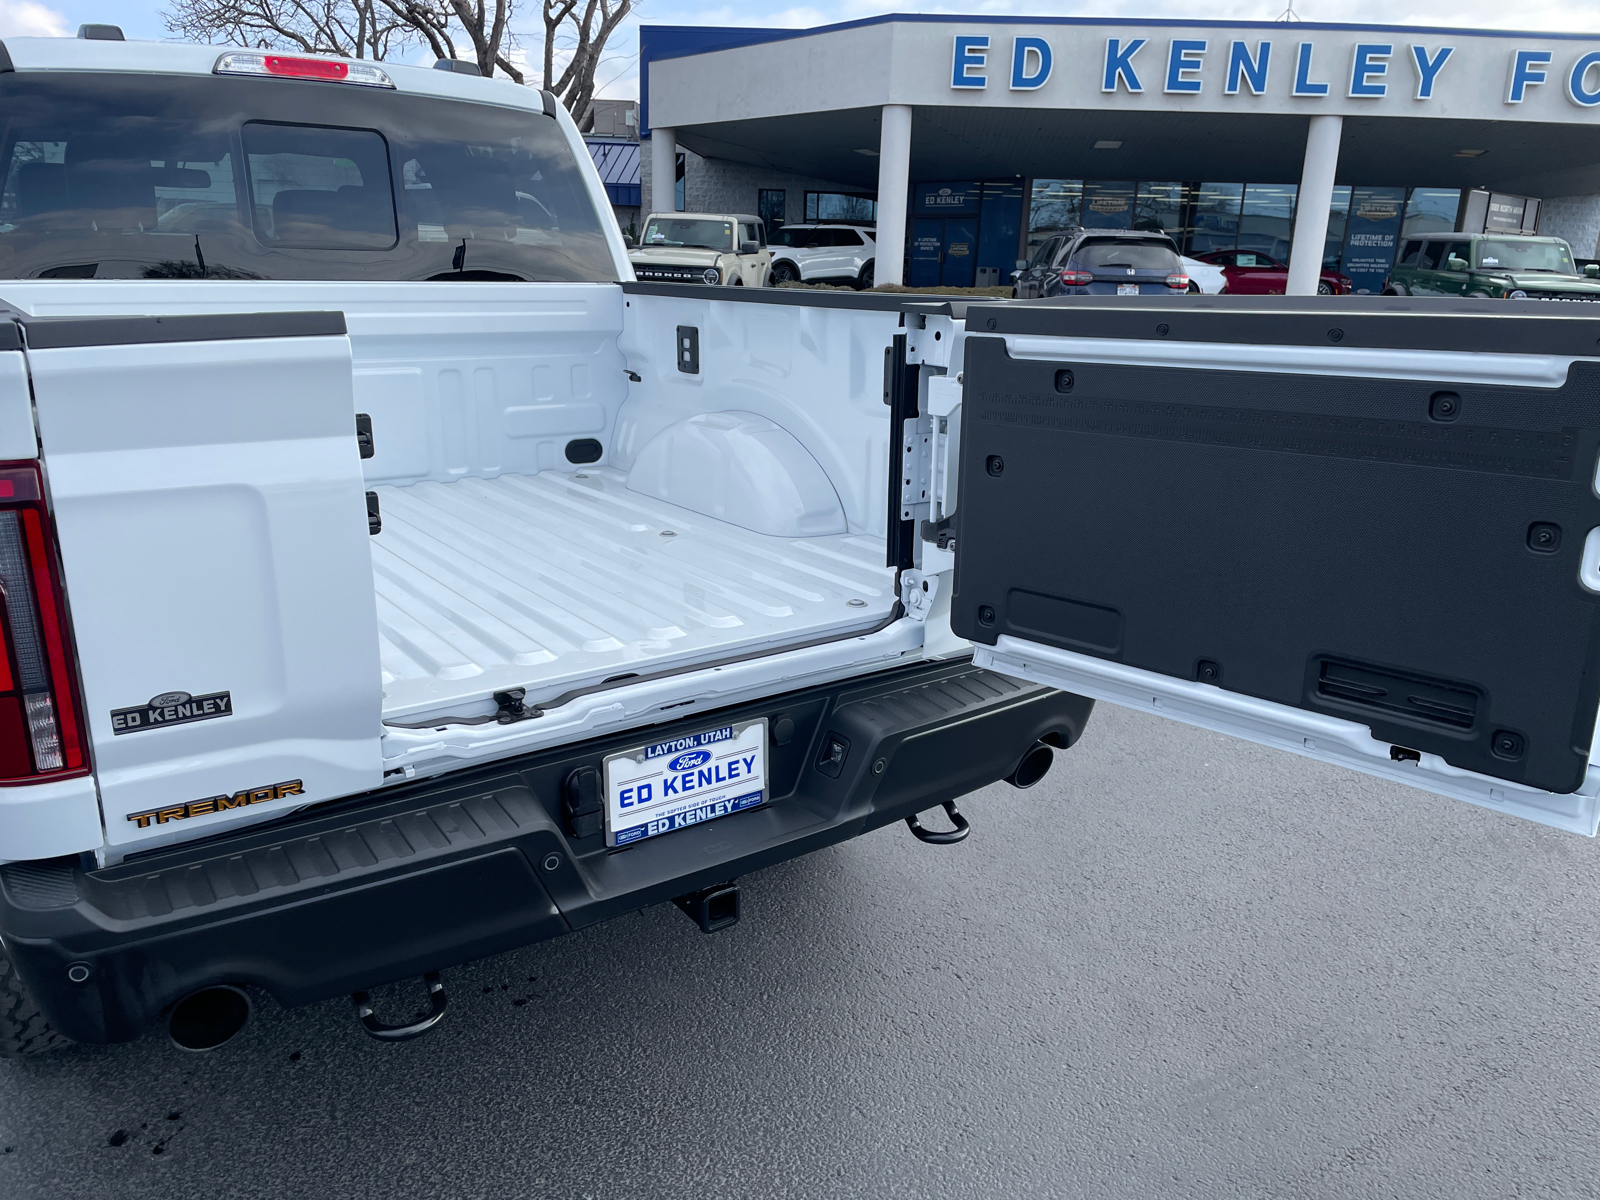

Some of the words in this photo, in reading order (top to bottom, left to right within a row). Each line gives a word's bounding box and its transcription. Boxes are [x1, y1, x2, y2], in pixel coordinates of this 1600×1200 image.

[951, 35, 1053, 90] ED
[1101, 38, 1456, 100] KENLEY
[926, 196, 934, 204] ED
[936, 196, 964, 204] KENLEY
[113, 713, 140, 729] ED
[149, 697, 229, 723] KENLEY
[648, 737, 697, 758] LAYTON,
[700, 728, 730, 743] UTAH
[619, 783, 652, 809] ED
[663, 755, 756, 797] KENLEY
[126, 778, 306, 828] TREMOR
[648, 819, 669, 835] ED
[675, 799, 734, 827] KENLEY
[667, 806, 686, 814] SOFTER
